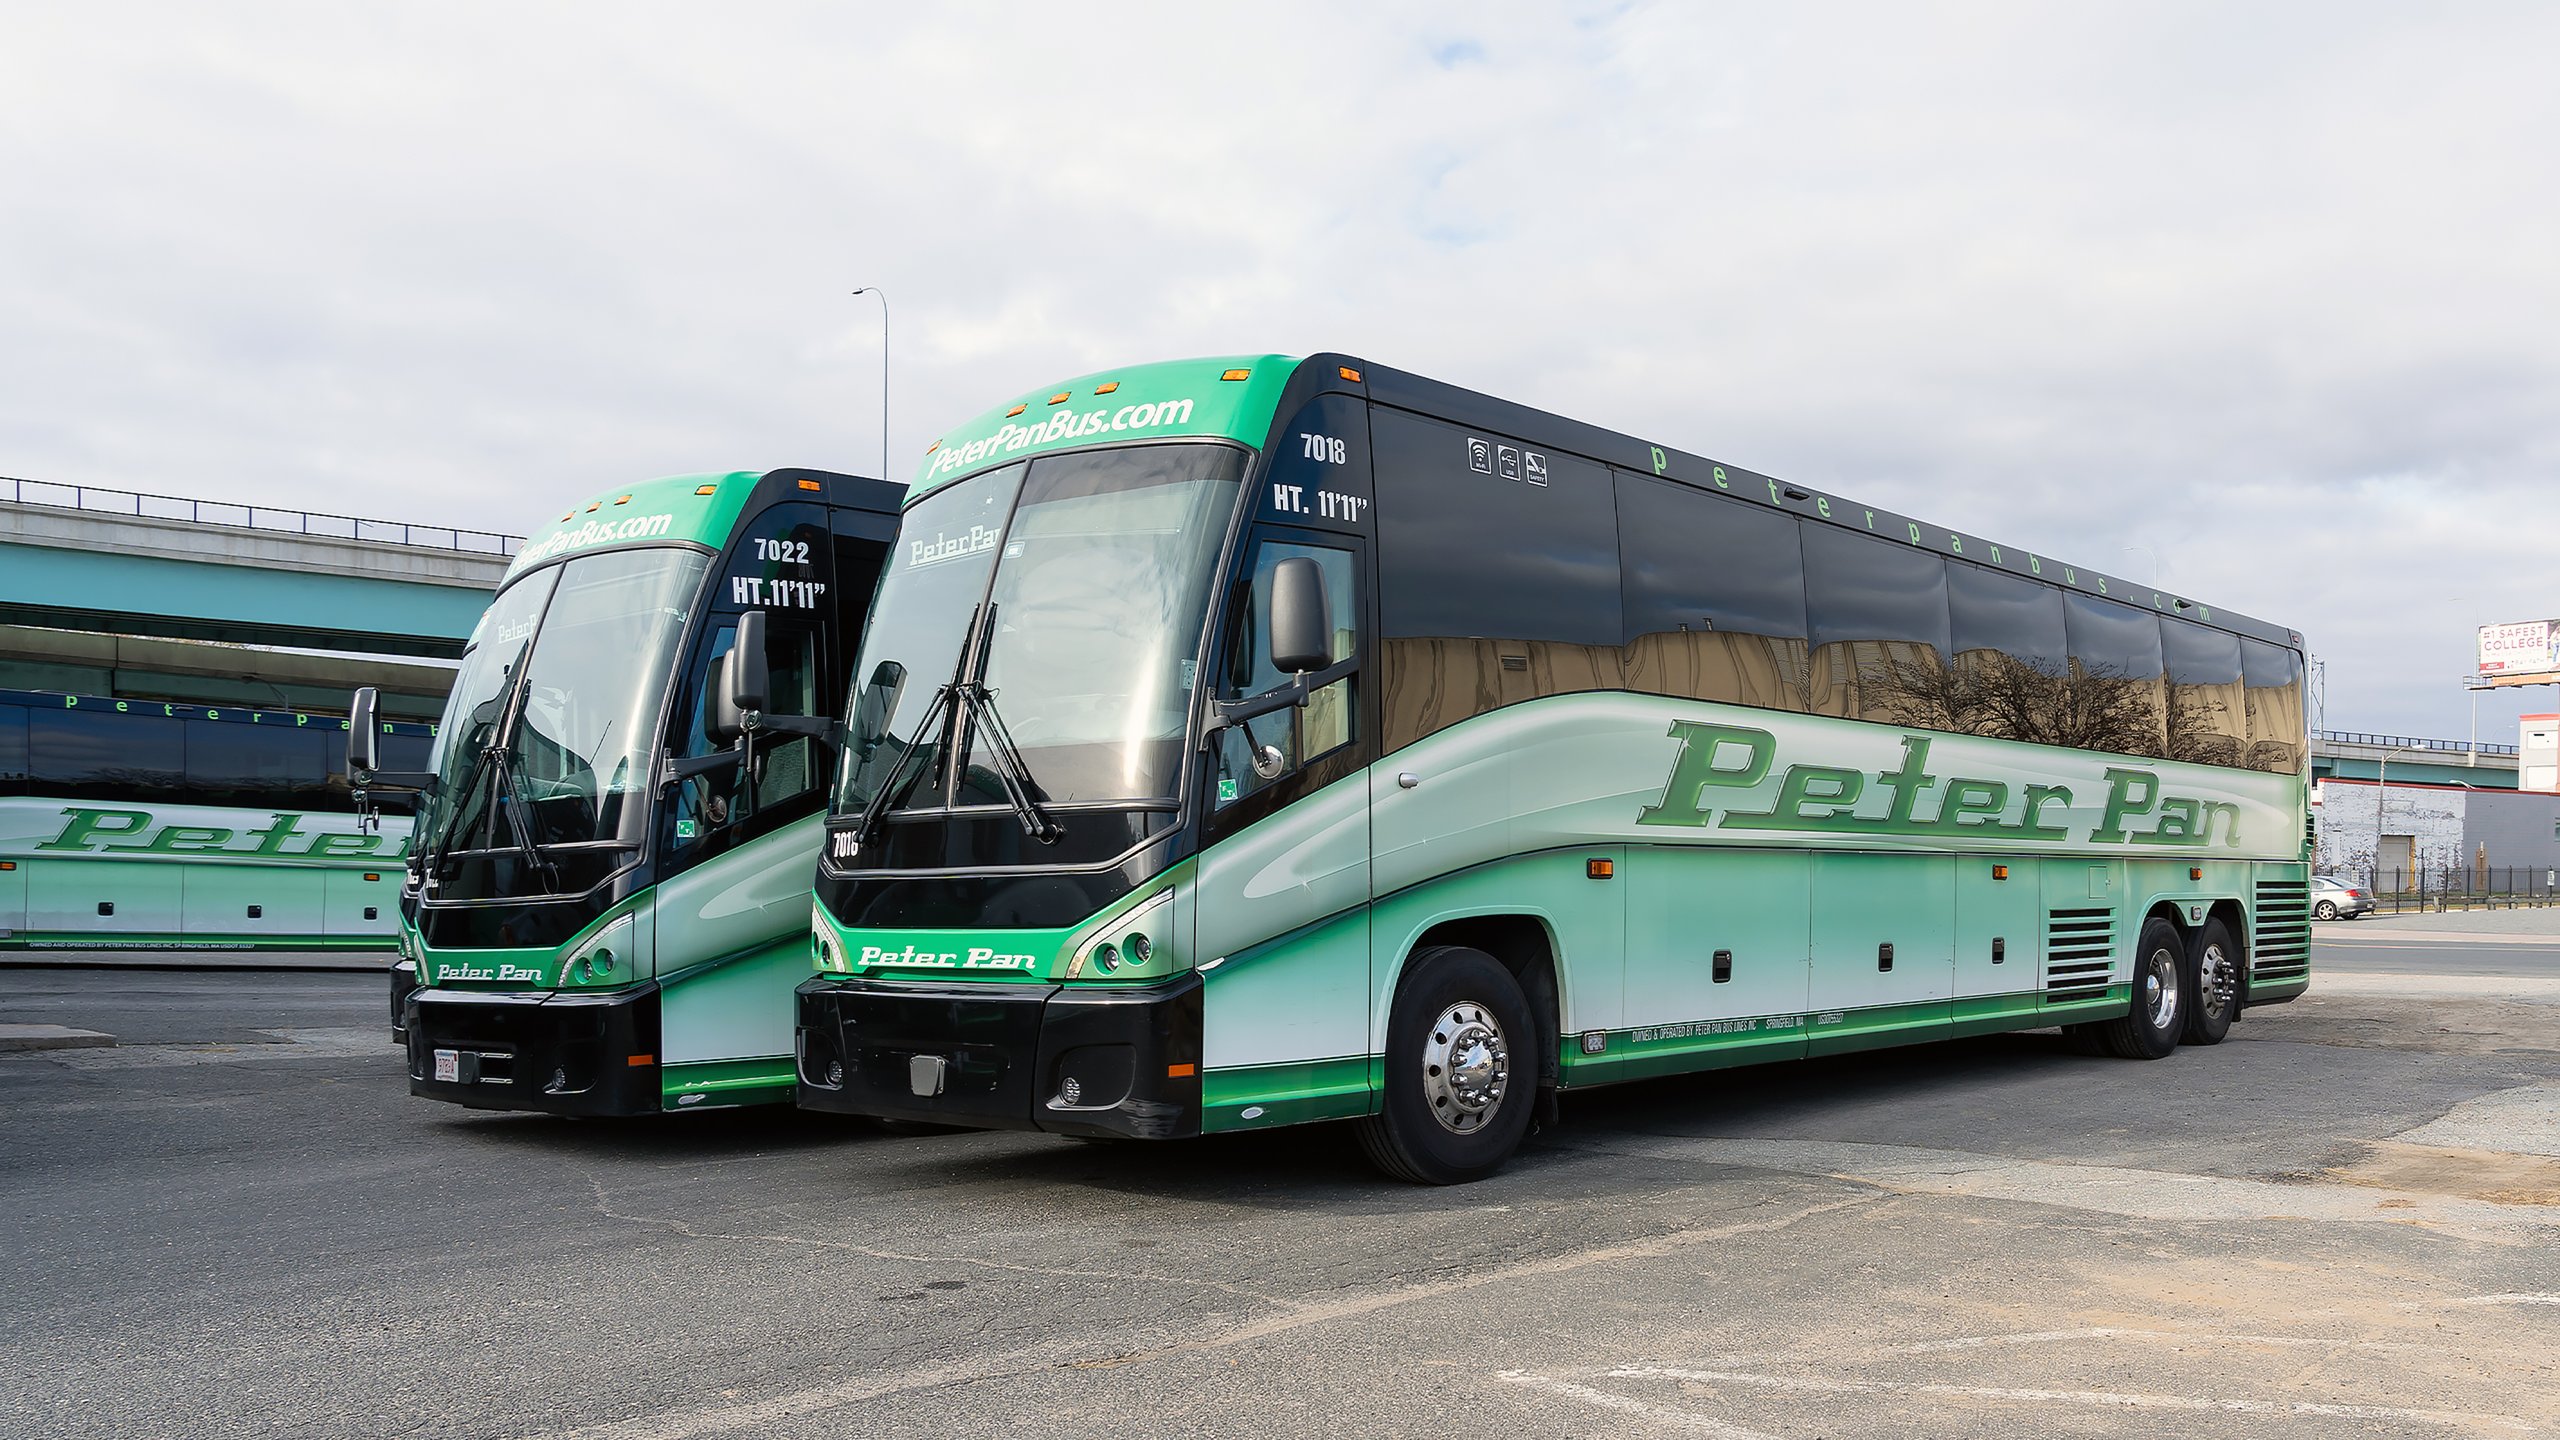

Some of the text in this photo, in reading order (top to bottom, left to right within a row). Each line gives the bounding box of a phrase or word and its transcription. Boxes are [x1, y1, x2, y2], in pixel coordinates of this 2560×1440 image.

[926, 398, 1194, 480] PeterPanBus.com
[1300, 433, 1346, 465] 7018
[1529, 474, 1545, 482] SAFETY
[1273, 483, 1310, 514] HT.
[754, 538, 809, 564] 7022
[2483, 625, 2544, 639] #1 SAFEST
[2484, 636, 2544, 651] COLLEGE
[1635, 718, 2242, 848] Peter Pan
[857, 945, 1036, 969] Peter Pan
[436, 962, 542, 981] Peter Pan
[1631, 1029, 1653, 1043] OWNED
[1653, 1029, 1658, 1041] &
[1659, 1026, 1685, 1040] OPERATED
[1686, 1025, 1693, 1037] BY
[1695, 1023, 1711, 1036] PETER
[1711, 1022, 1722, 1034] PAN
[1722, 1021, 1734, 1033] BUS
[1733, 1020, 1748, 1032] LINES
